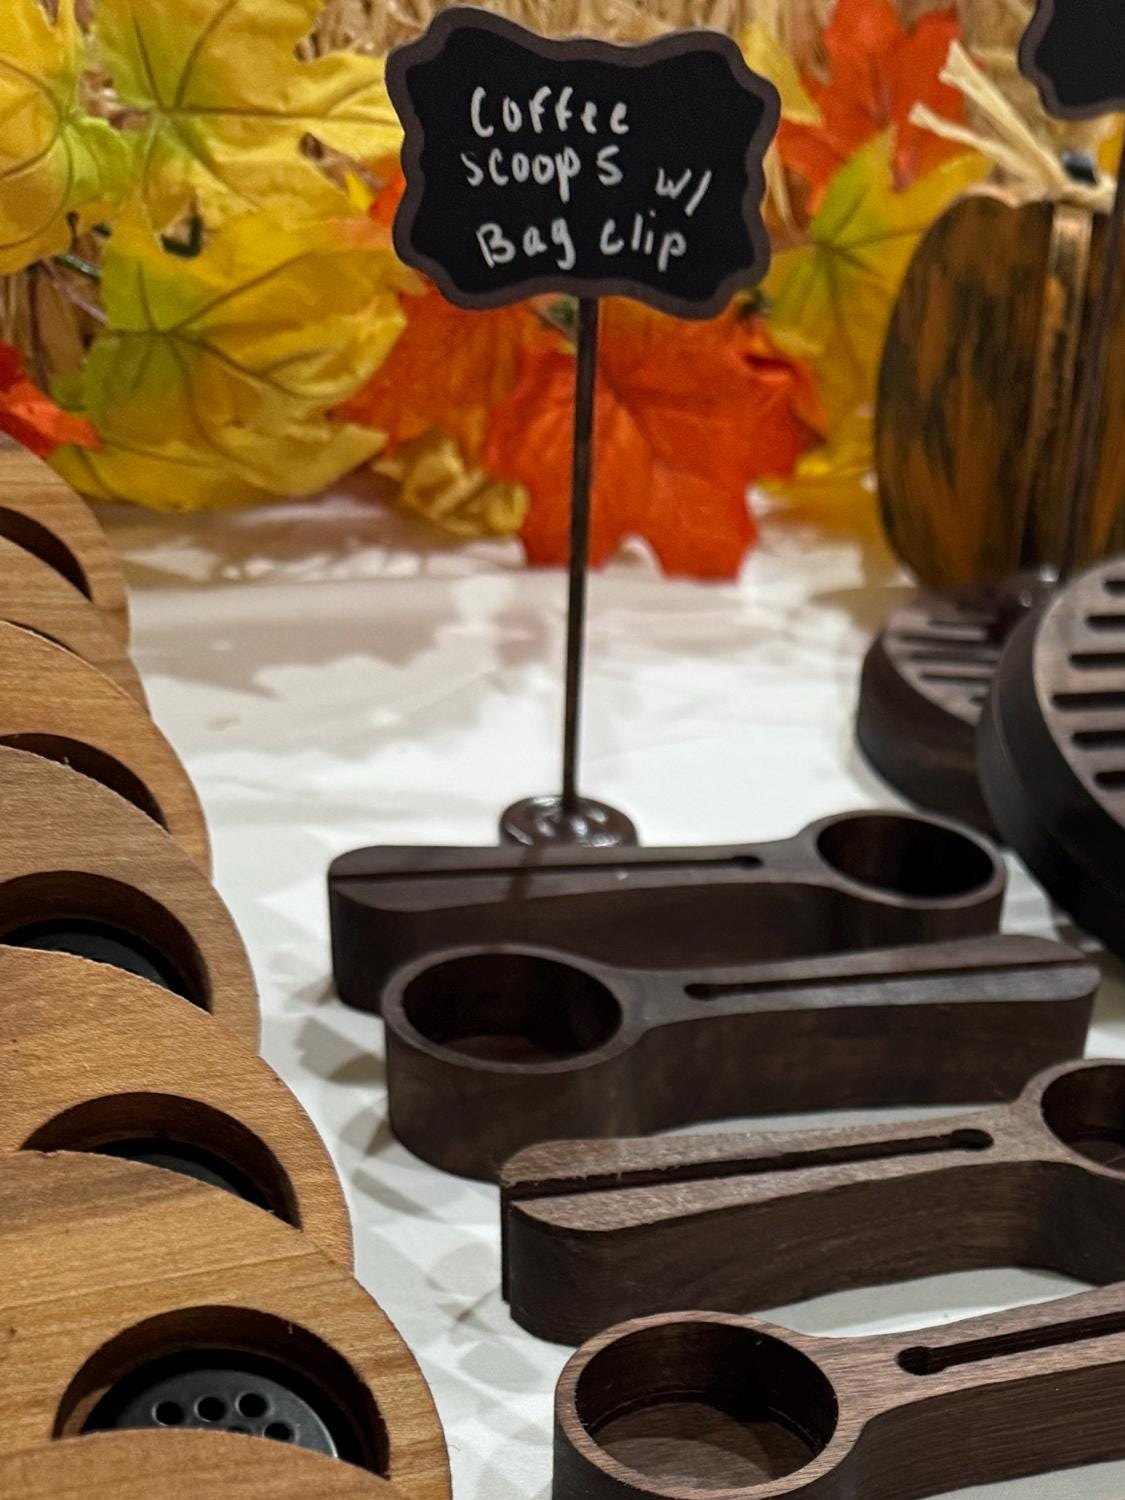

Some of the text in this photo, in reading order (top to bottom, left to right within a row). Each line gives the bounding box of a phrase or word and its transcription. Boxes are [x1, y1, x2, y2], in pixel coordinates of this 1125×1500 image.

[470, 85, 630, 138] Coffee
[654, 167, 713, 217] w/
[475, 209, 687, 272] Bag clip
